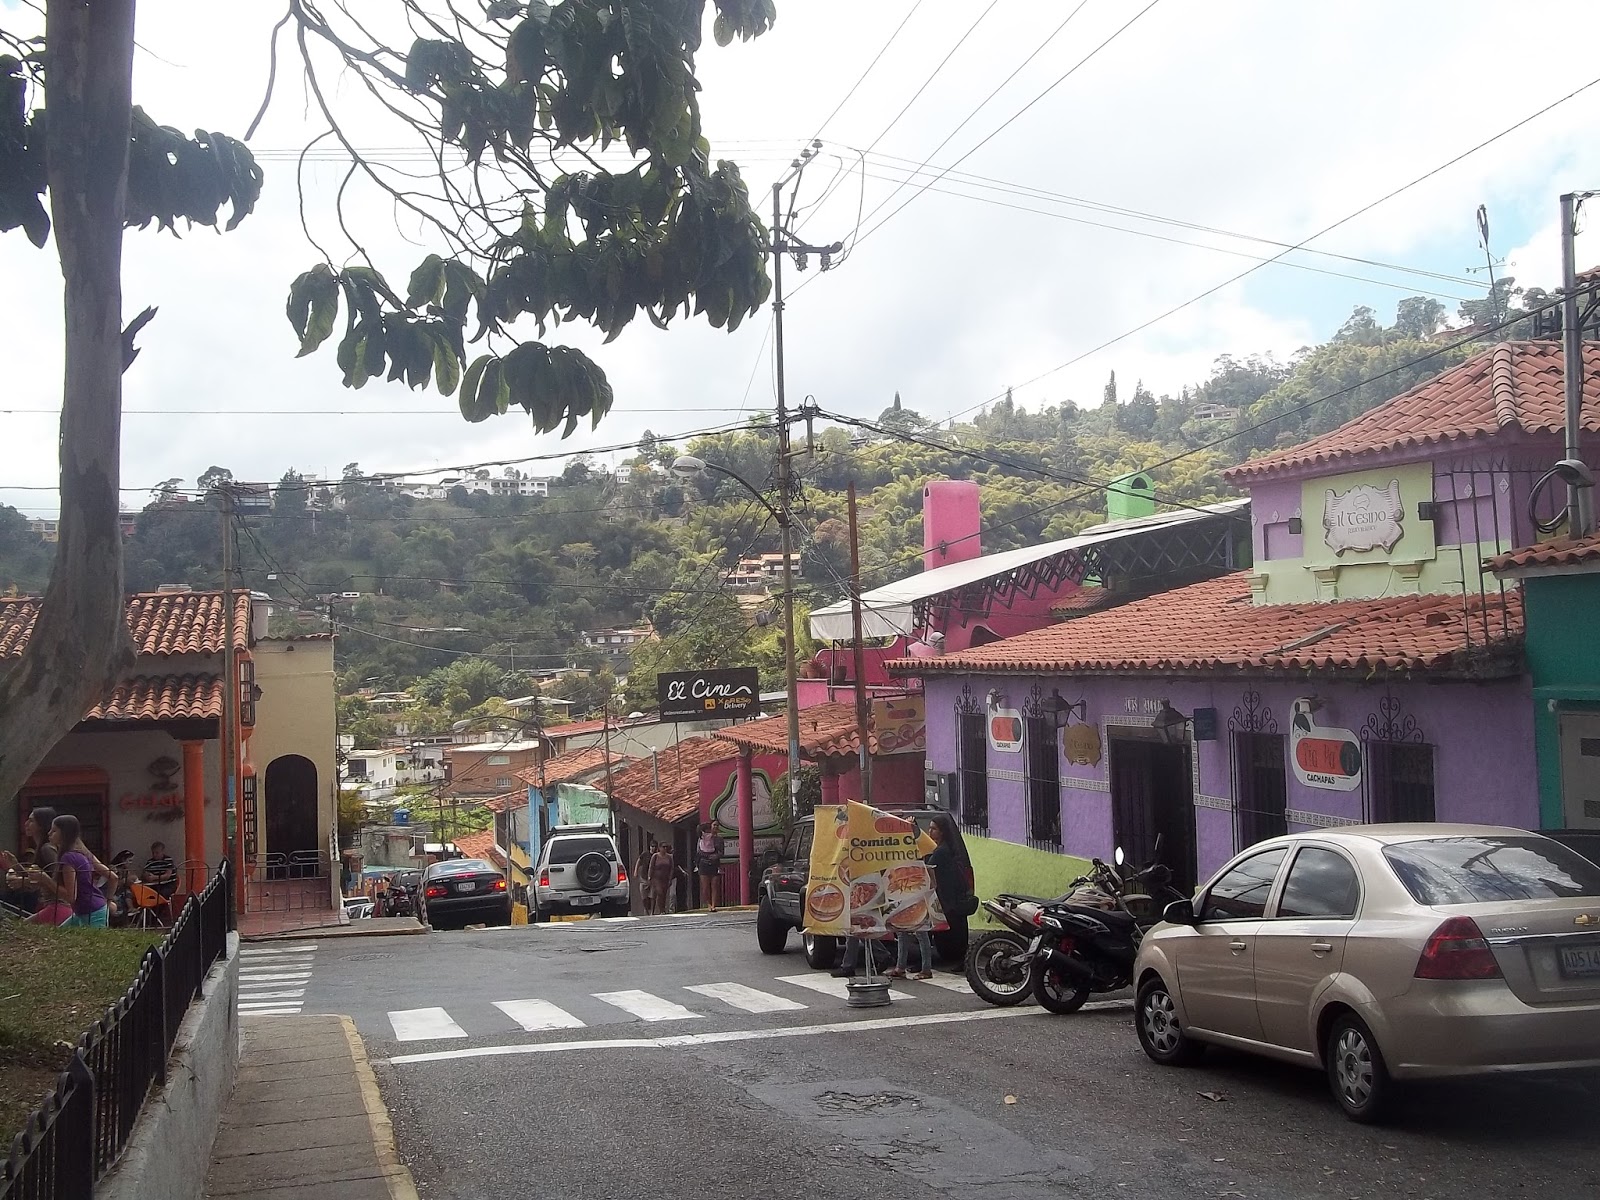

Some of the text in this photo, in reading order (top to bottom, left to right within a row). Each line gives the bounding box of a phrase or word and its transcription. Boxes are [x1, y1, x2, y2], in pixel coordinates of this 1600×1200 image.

[667, 678, 752, 701] El Cine
[724, 702, 747, 710] Delivery
[1306, 773, 1336, 785] CACHAPAS
[850, 836, 900, 848] Comida
[850, 847, 920, 862] Gourmet
[1565, 950, 1600, 968] AD514
